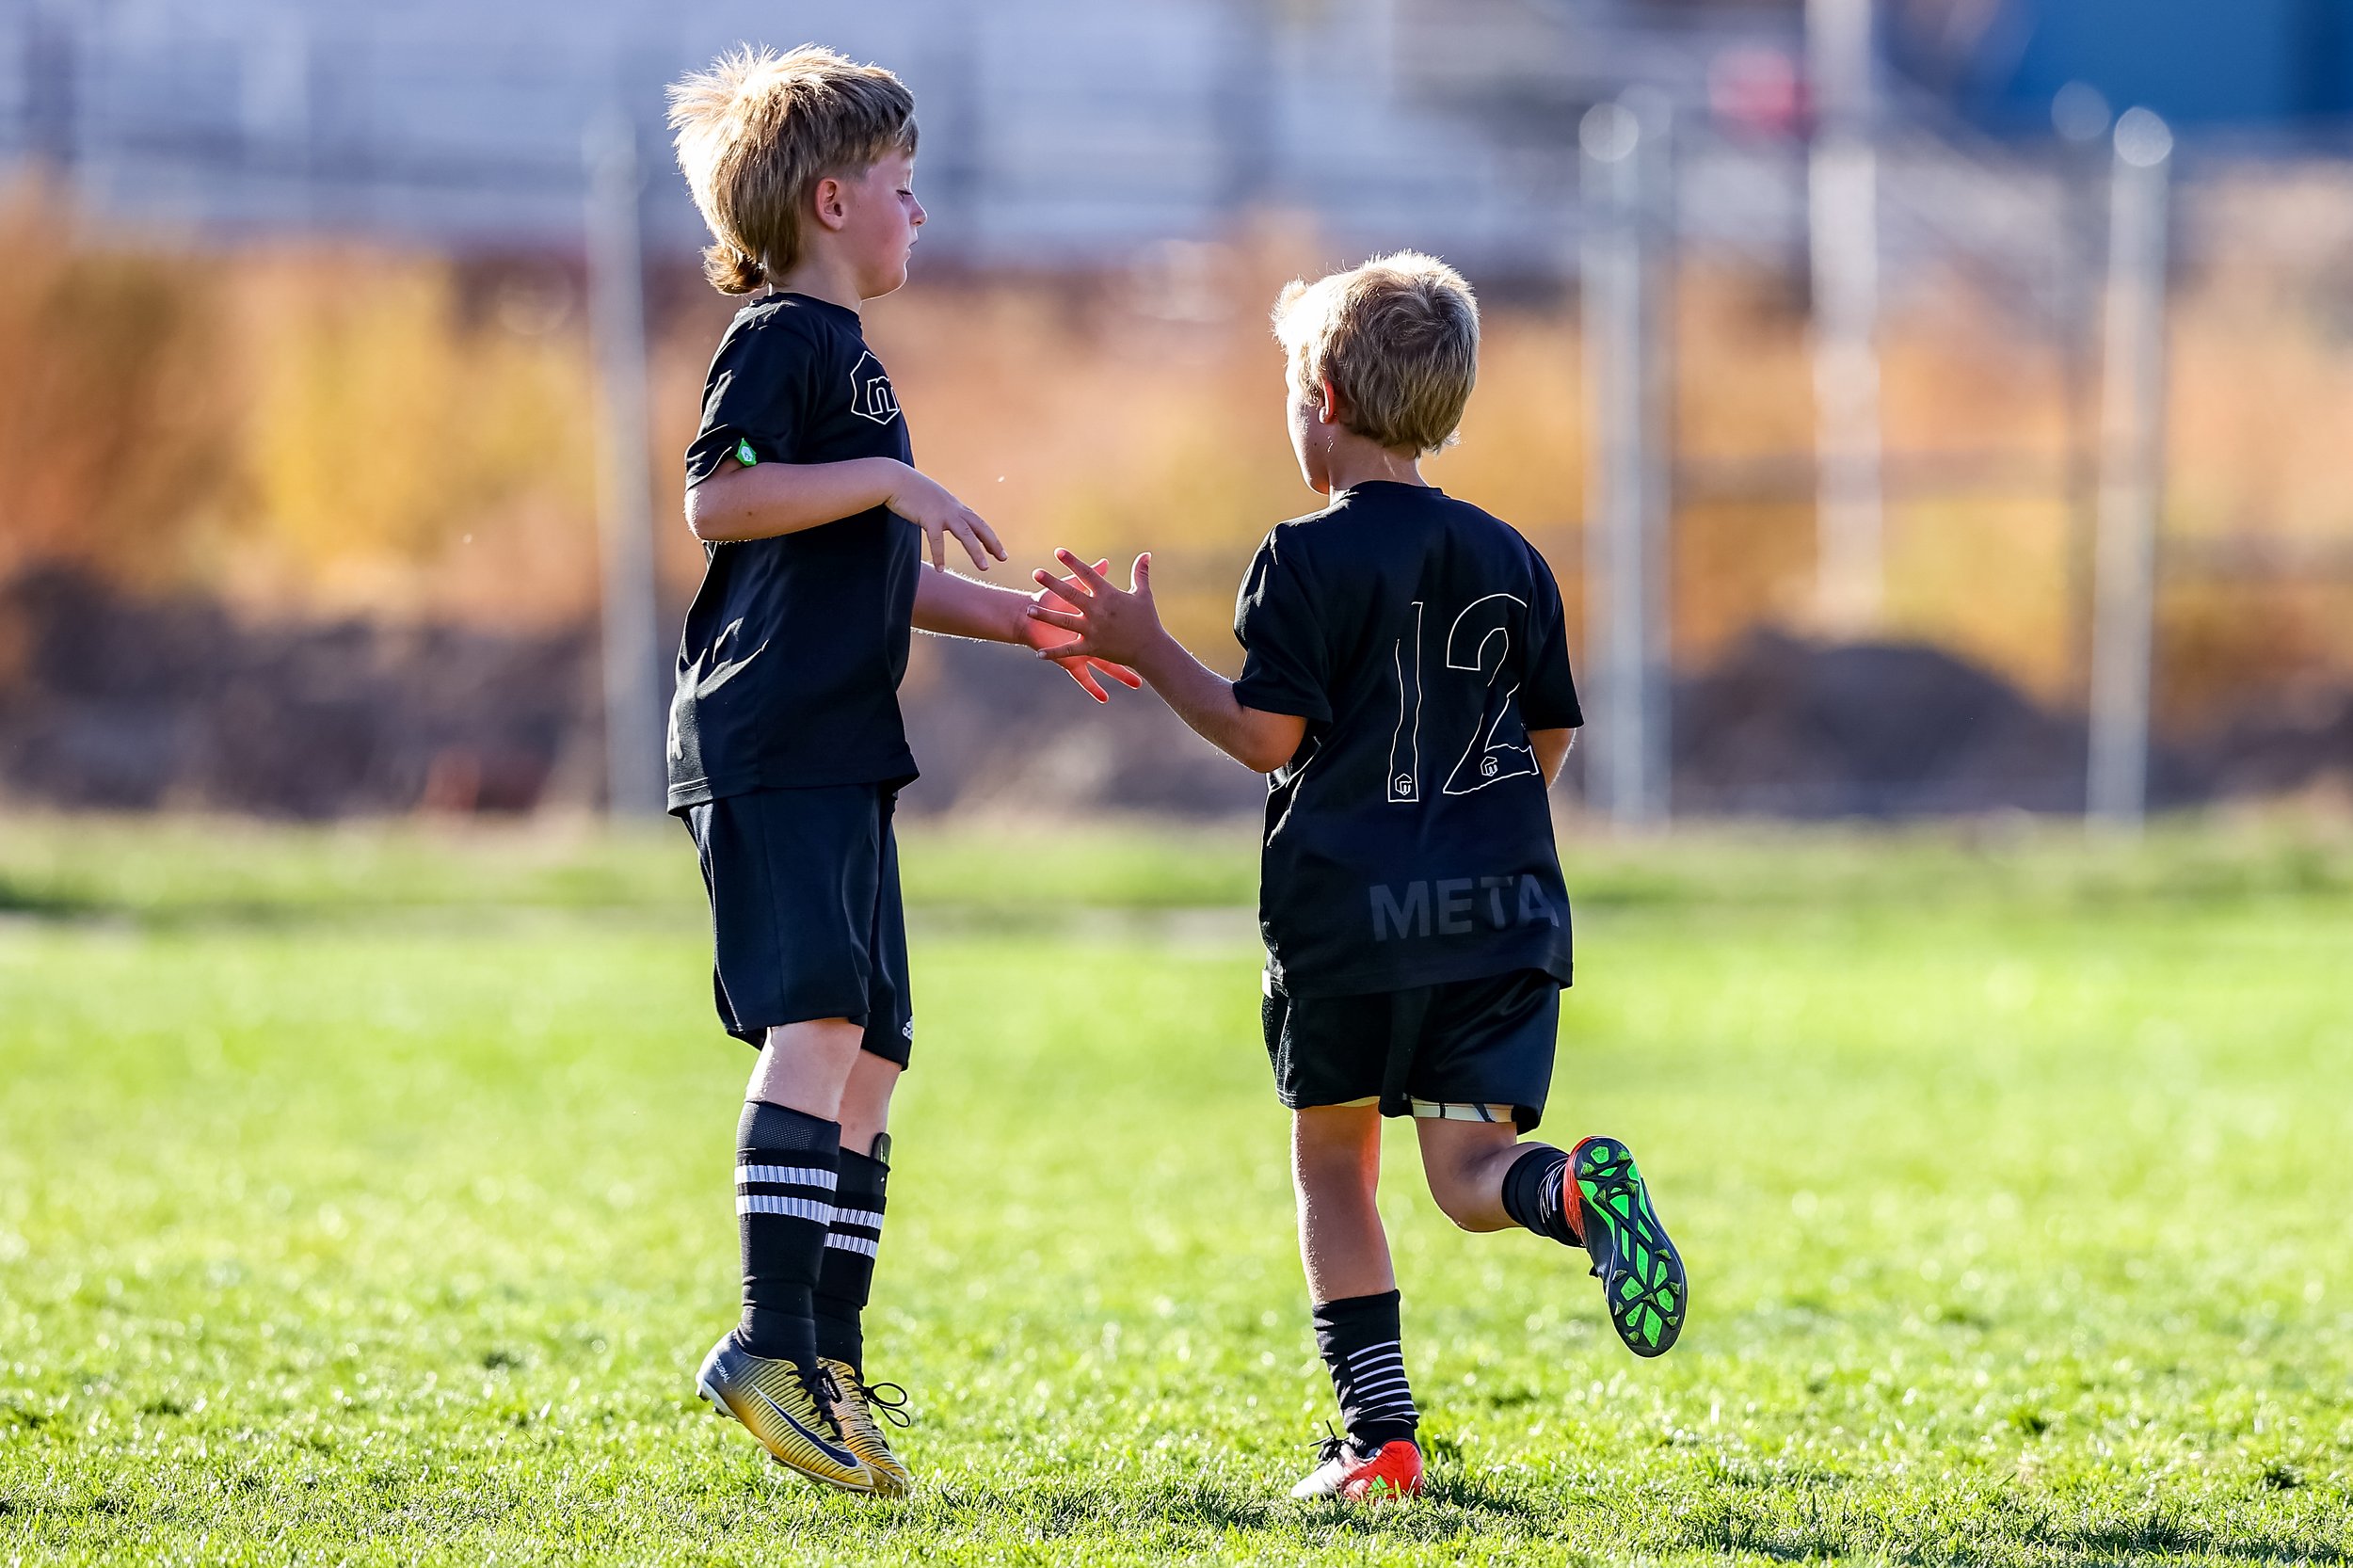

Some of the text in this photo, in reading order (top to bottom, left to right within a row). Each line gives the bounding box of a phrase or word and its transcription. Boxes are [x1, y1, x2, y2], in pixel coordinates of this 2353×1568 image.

[1388, 593, 1539, 802] 12
[1369, 873, 1560, 941] META
[714, 1357, 731, 1384] CURIAL
